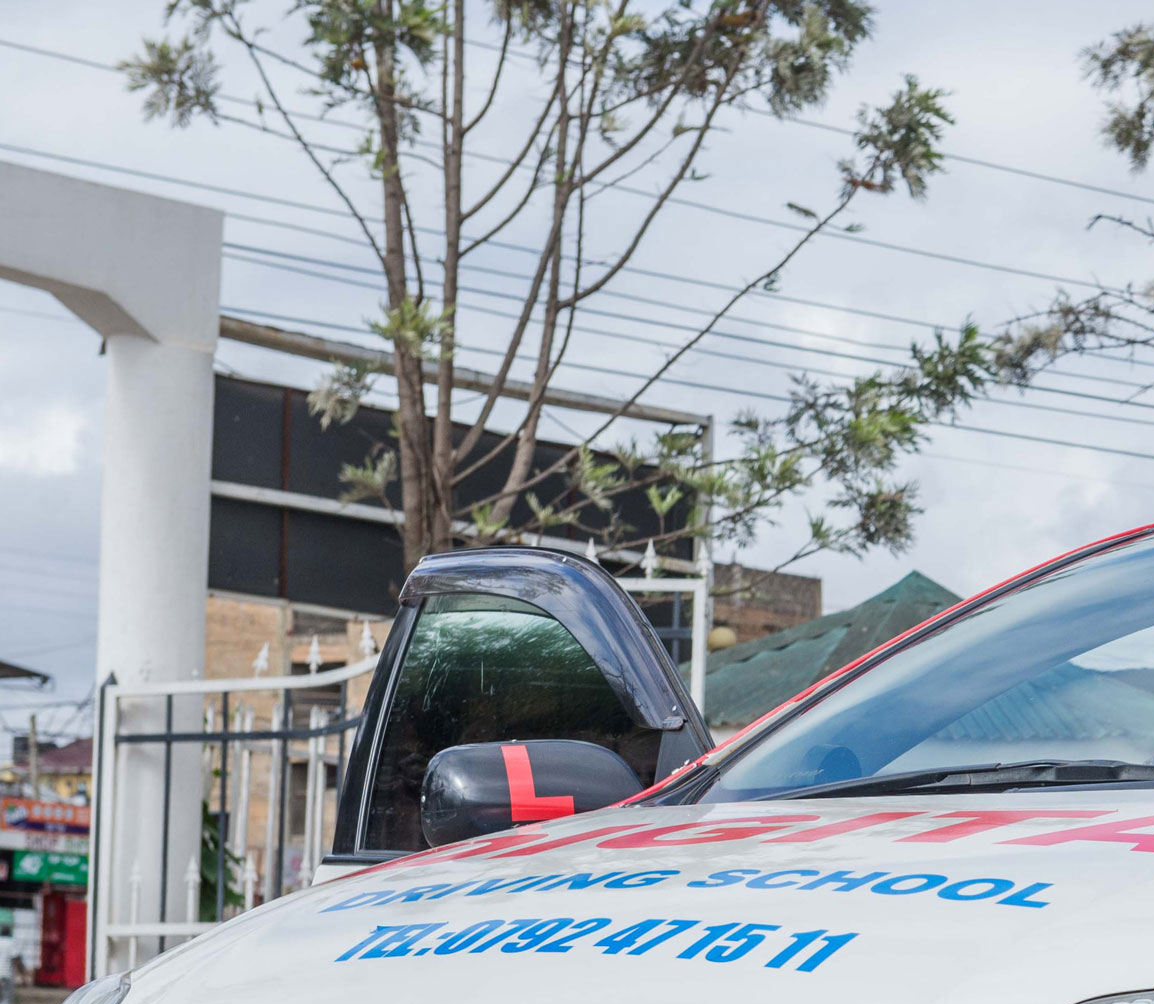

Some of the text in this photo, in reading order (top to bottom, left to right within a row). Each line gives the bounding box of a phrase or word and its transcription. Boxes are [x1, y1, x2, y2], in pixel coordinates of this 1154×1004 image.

[500, 745, 576, 822] L
[318, 869, 1054, 913] DRIVING SCHOOL
